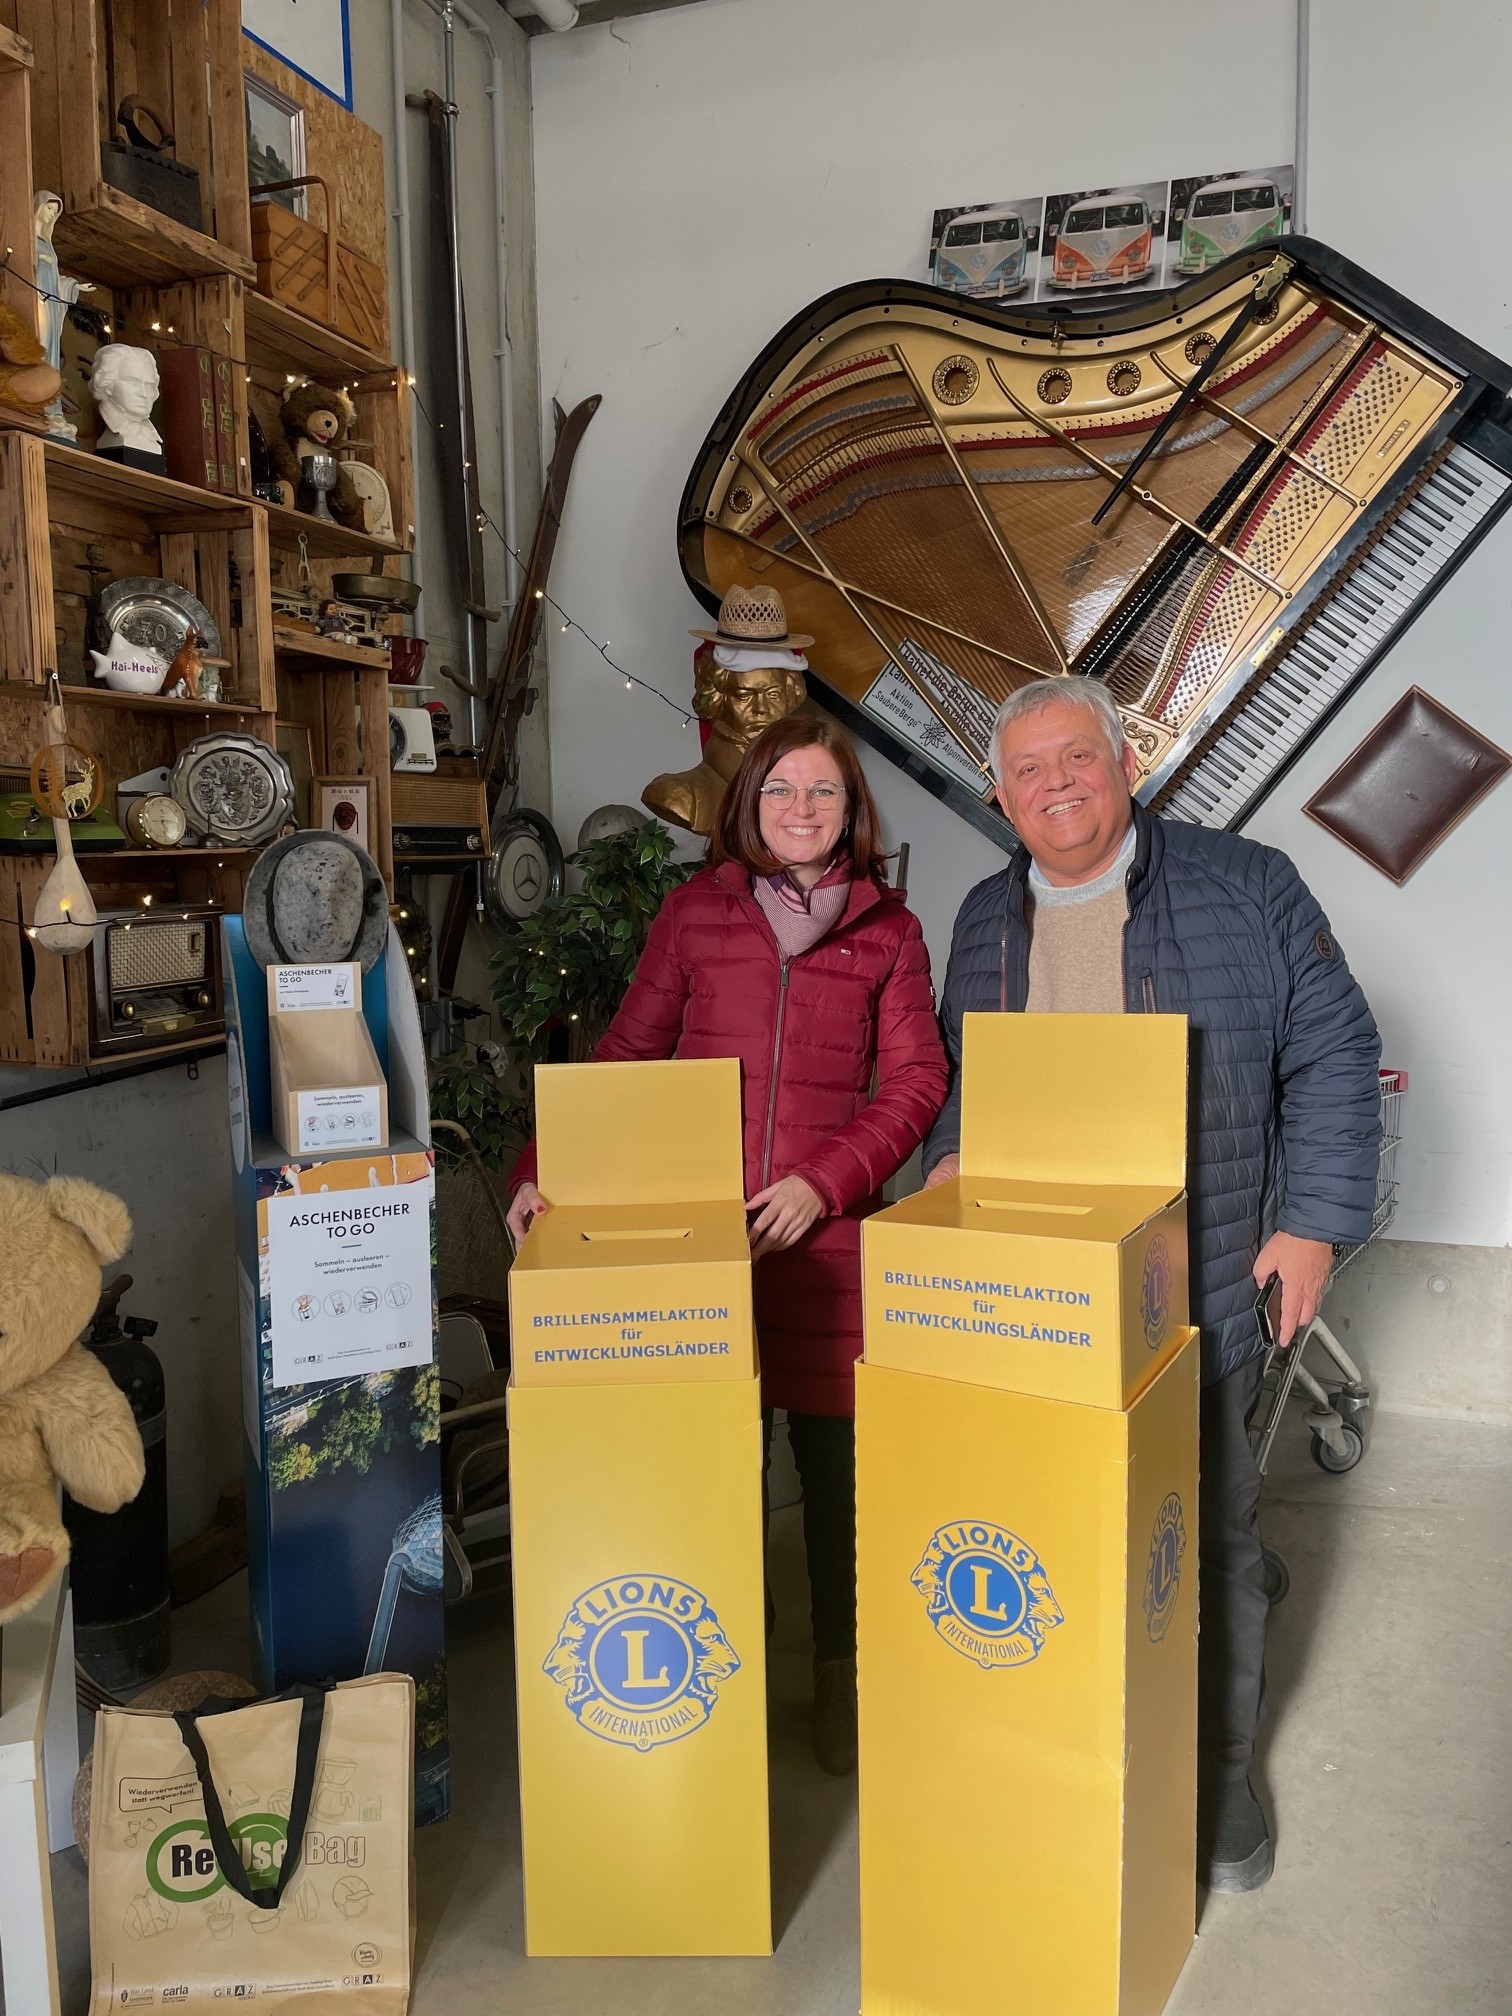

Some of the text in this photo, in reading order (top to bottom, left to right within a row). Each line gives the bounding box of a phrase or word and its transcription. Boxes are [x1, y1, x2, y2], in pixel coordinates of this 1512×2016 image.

[111, 661, 158, 674] Hai-Heels
[890, 688, 914, 711] Aktion
[942, 743, 981, 775] Alpenverein
[279, 969, 332, 977] ASCHENBECHER
[289, 1203, 410, 1227] ASCHENBECHER
[327, 1223, 375, 1239] TO GO
[313, 1259, 345, 1268] Sammeln
[352, 1255, 384, 1263] ausleeren
[323, 1263, 382, 1275] wiederverwenden
[884, 1271, 1091, 1306] BRILLENSAMMELAKTION
[533, 1307, 729, 1327] BRILLENSAMMELAKTION
[973, 1300, 996, 1315] für
[621, 1328, 643, 1340] für
[885, 1309, 1092, 1348] ENTWICKLUNGSLÄNDER
[534, 1341, 730, 1363] ENTWICKLUNGSLÄNDER
[943, 1526, 1030, 1567] LIONS
[1160, 1541, 1172, 1593] L
[584, 1581, 696, 1620] LIONS
[970, 1564, 1007, 1621] L
[943, 1621, 1029, 1660] INTERNATIONAL
[621, 1630, 671, 1688] L
[588, 1705, 698, 1737] INTERNATIONAL
[128, 1781, 198, 1796] Wiederverwenden
[149, 1788, 194, 1801] wegwerfen!
[305, 1831, 366, 1868] Bag
[162, 1984, 189, 1996] carla
[342, 1974, 382, 1986] GRAZ
[213, 1985, 254, 1998] GRAZ
